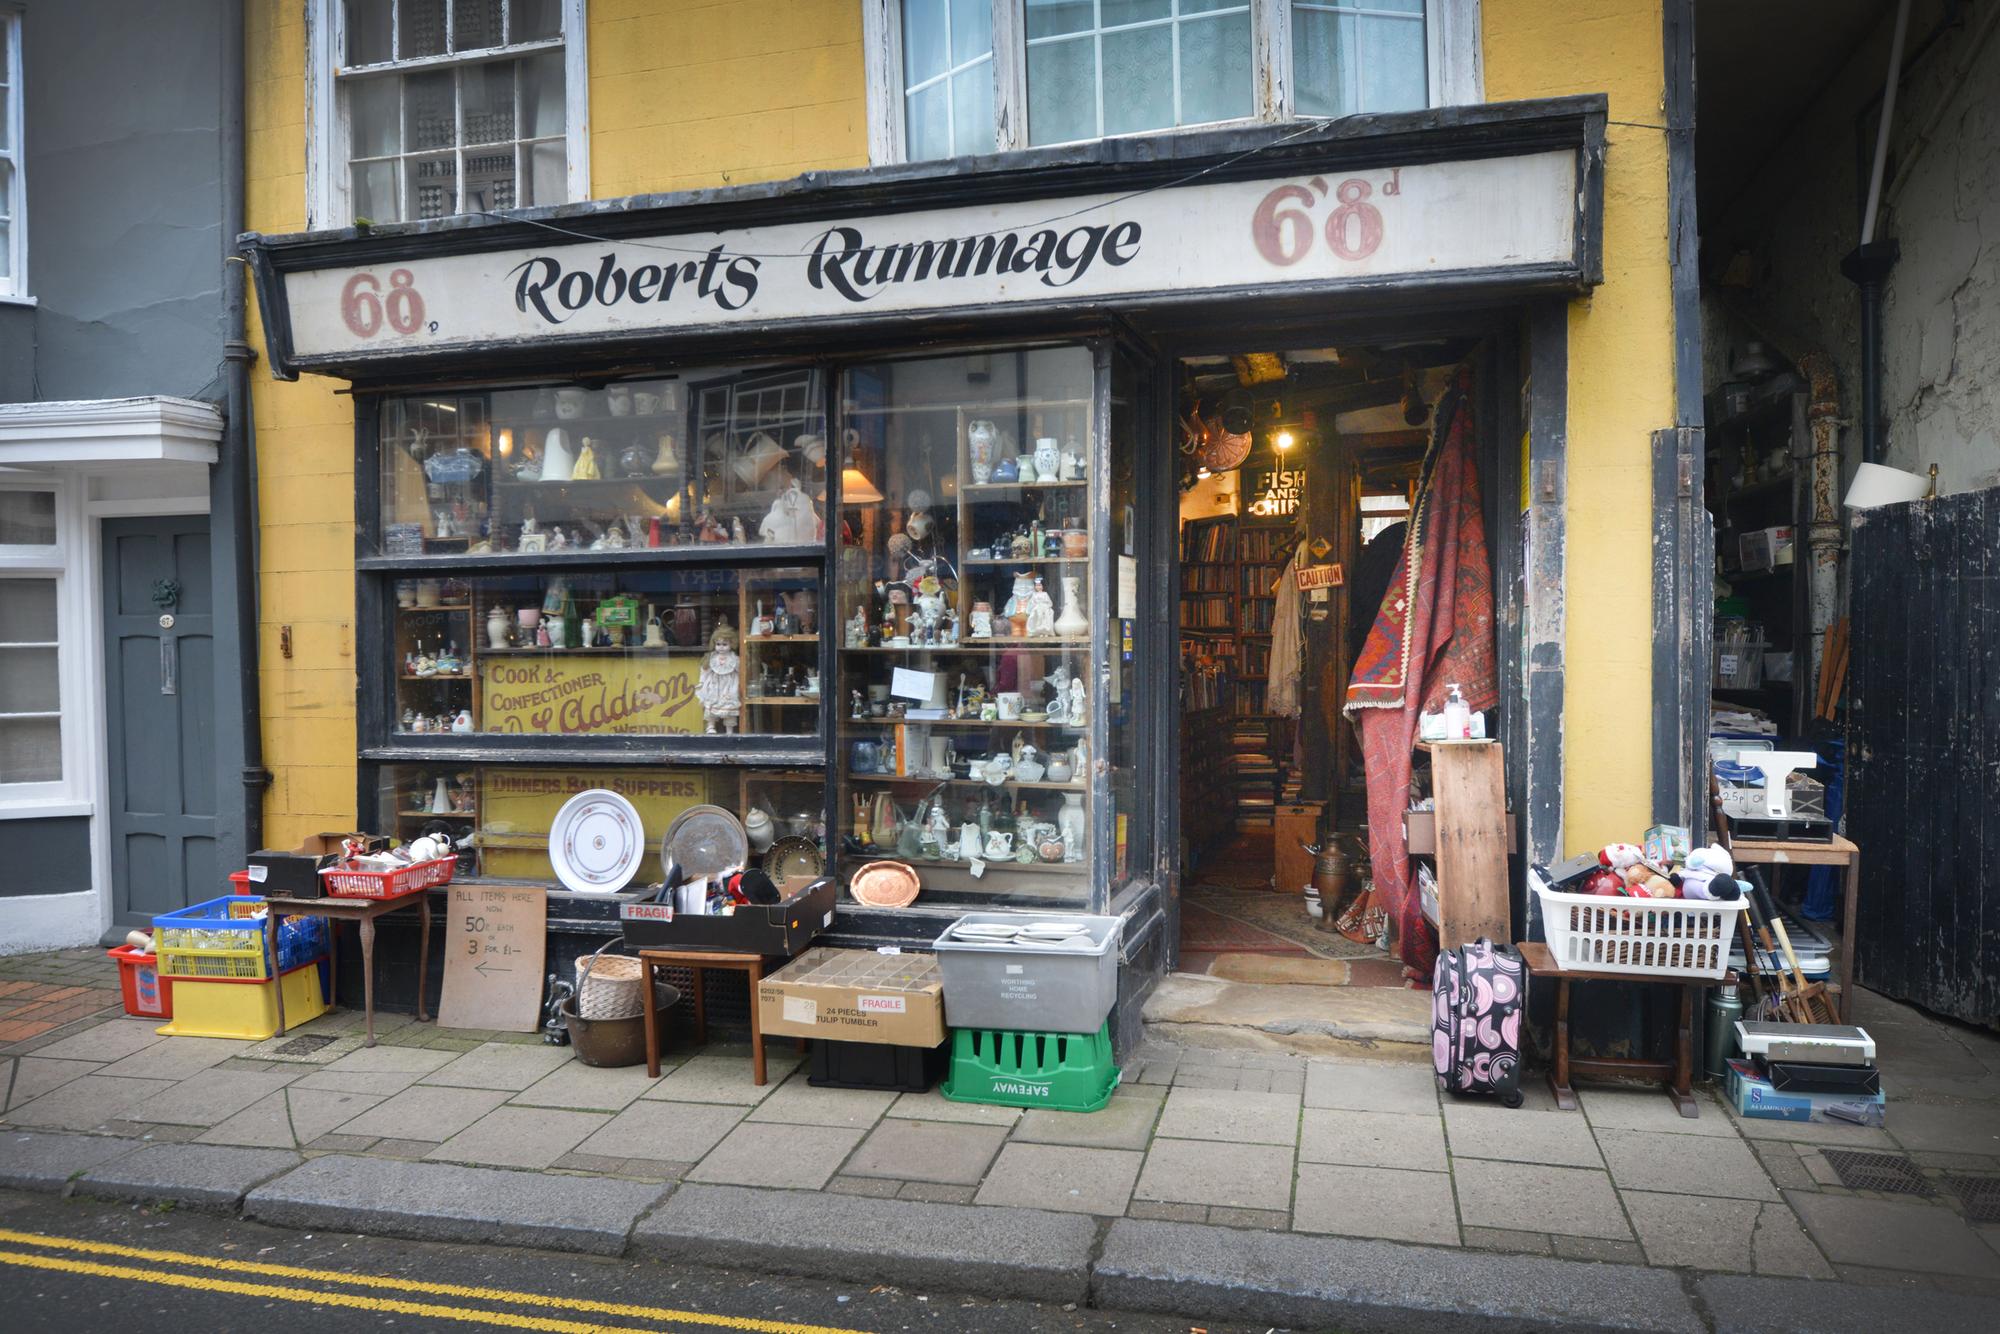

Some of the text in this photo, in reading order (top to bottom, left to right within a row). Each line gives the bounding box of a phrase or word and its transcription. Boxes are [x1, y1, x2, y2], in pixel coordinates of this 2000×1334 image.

[504, 221, 1142, 324] Roberts Rummage
[341, 268, 425, 339] 68
[1257, 470, 1306, 489] FISH
[1265, 488, 1300, 499] AND
[1300, 567, 1340, 587] CAUTION
[456, 891, 534, 903] ALL ITEMS HERE
[497, 924, 514, 932] EACH
[468, 939, 478, 955] 3
[484, 944, 499, 953] FOR
[1000, 978, 1036, 986] WORTHING
[1000, 992, 1037, 1000] RECYCLING
[862, 999, 901, 1009] FRAGILE
[837, 1008, 867, 1017] PIECES
[841, 1017, 878, 1027] TUMBLER
[993, 1082, 1049, 1097] SAFEWAY
